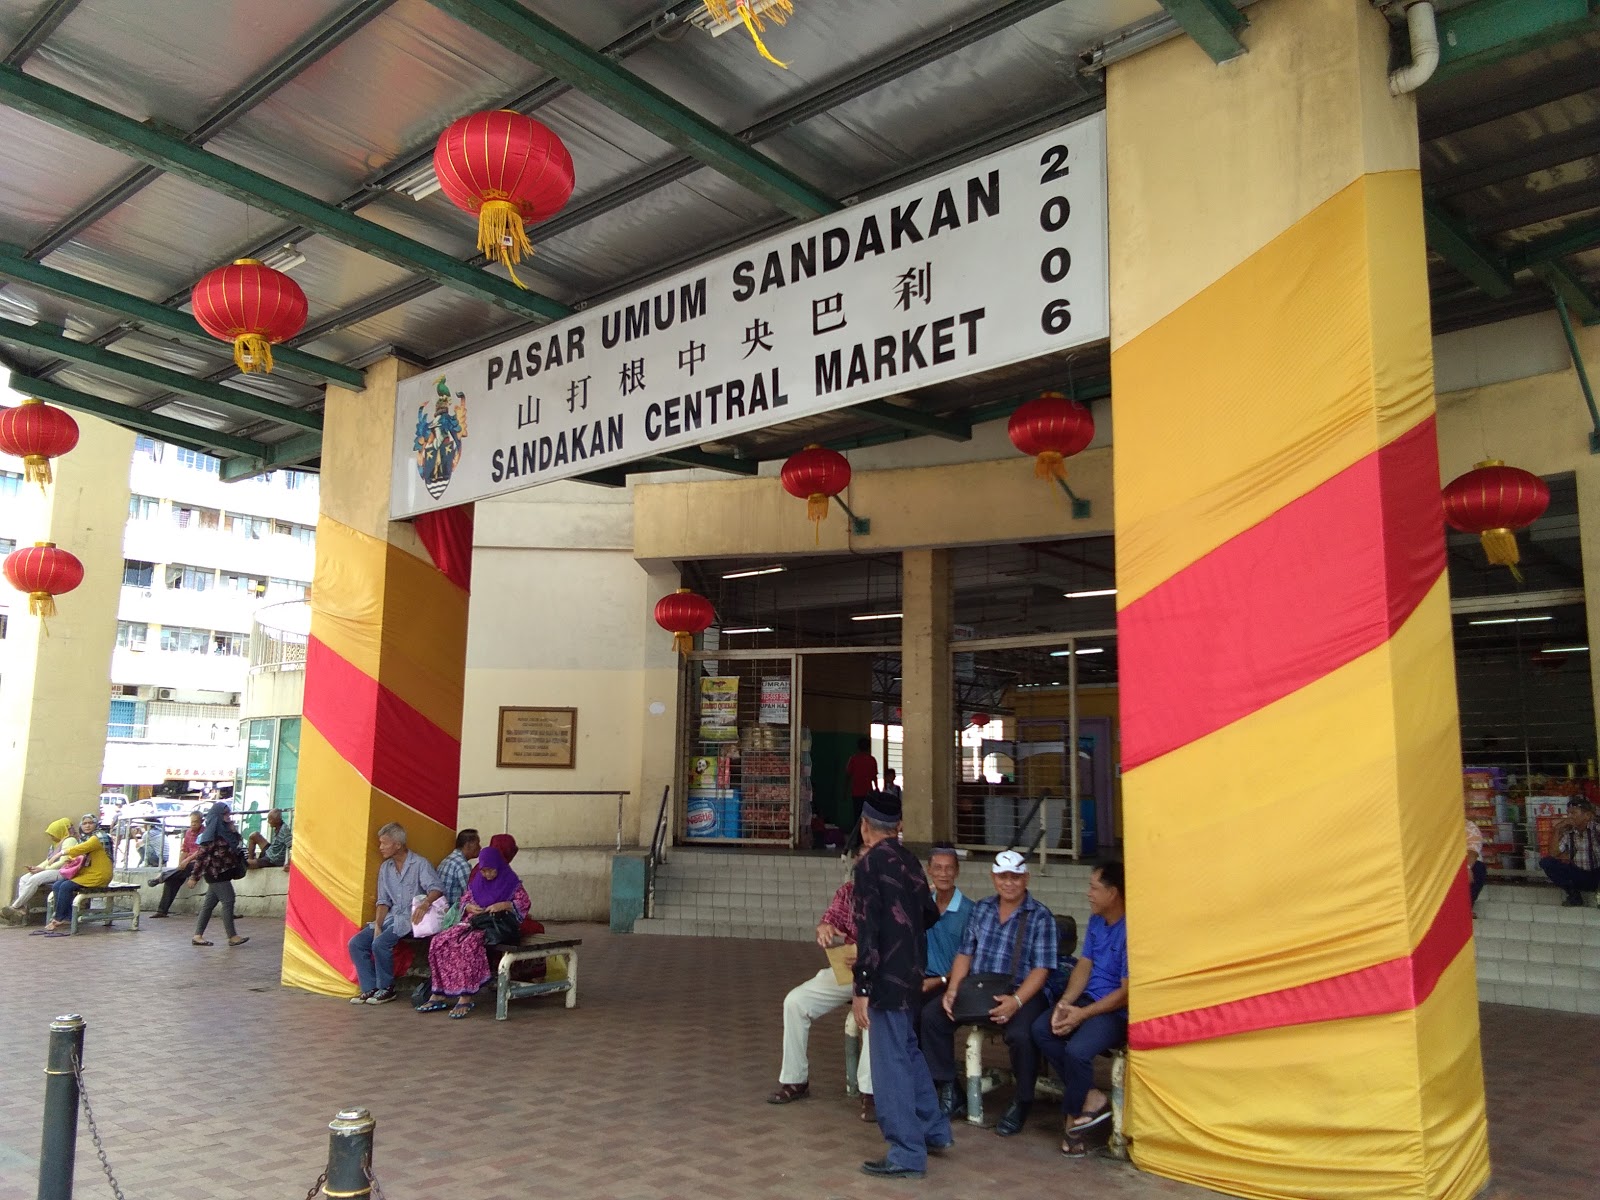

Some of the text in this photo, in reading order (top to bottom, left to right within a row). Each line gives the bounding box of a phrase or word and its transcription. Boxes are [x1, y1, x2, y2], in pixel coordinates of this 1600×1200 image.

[486, 169, 1001, 391] PASAR UMUM SANDAKAN
[1039, 144, 1072, 335] 2006
[490, 307, 987, 483] SANDAKAN CENTRAL MARKET
